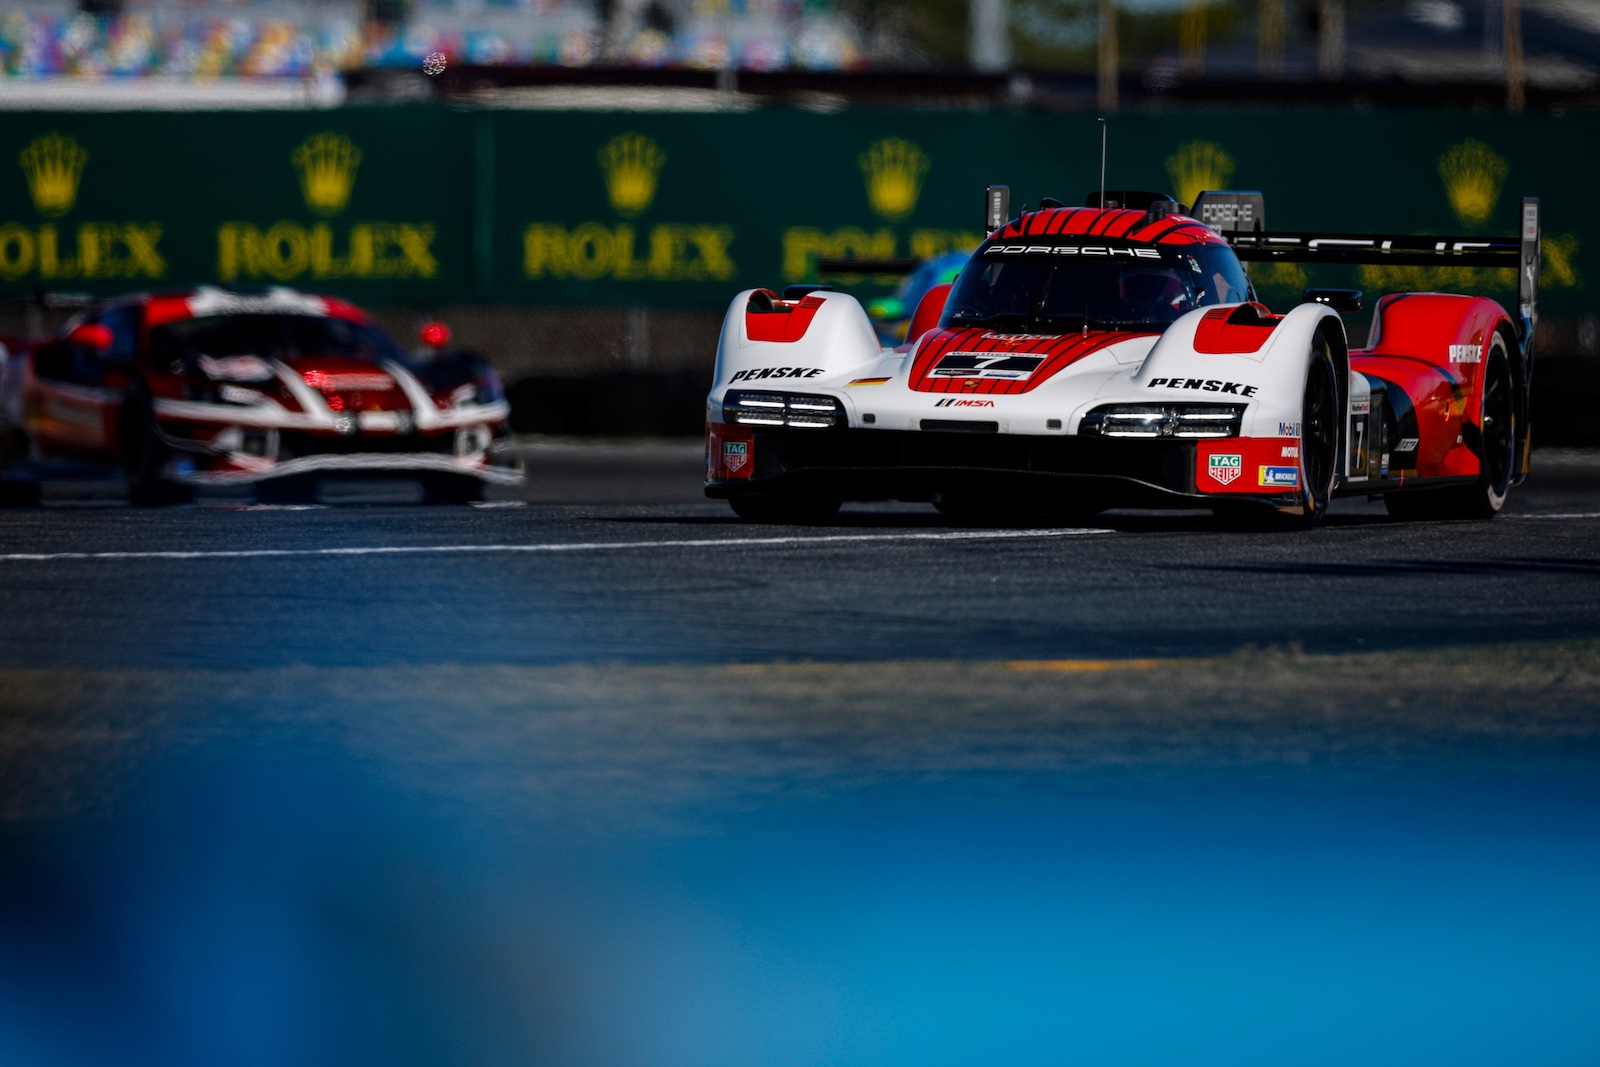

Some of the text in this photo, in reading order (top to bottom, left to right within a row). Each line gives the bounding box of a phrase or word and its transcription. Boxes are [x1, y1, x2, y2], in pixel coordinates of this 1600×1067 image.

[1202, 204, 1252, 221] PORSCHE
[0, 222, 165, 280] OLEX
[217, 221, 438, 281] ROLEX
[523, 222, 735, 282] ROLEX
[984, 246, 1161, 259] PORSCHE
[1449, 344, 1483, 363] PENSKE
[973, 355, 1010, 369] 7
[728, 367, 826, 385] PENSKE
[1147, 378, 1259, 398] PENSKE
[954, 399, 995, 408] IMSA
[1278, 422, 1295, 436] Mobil
[726, 444, 745, 453] TAG
[1356, 421, 1364, 470] 7
[725, 454, 746, 470] HEUER
[1212, 456, 1239, 467] TAG
[1210, 468, 1240, 483] HEUER
